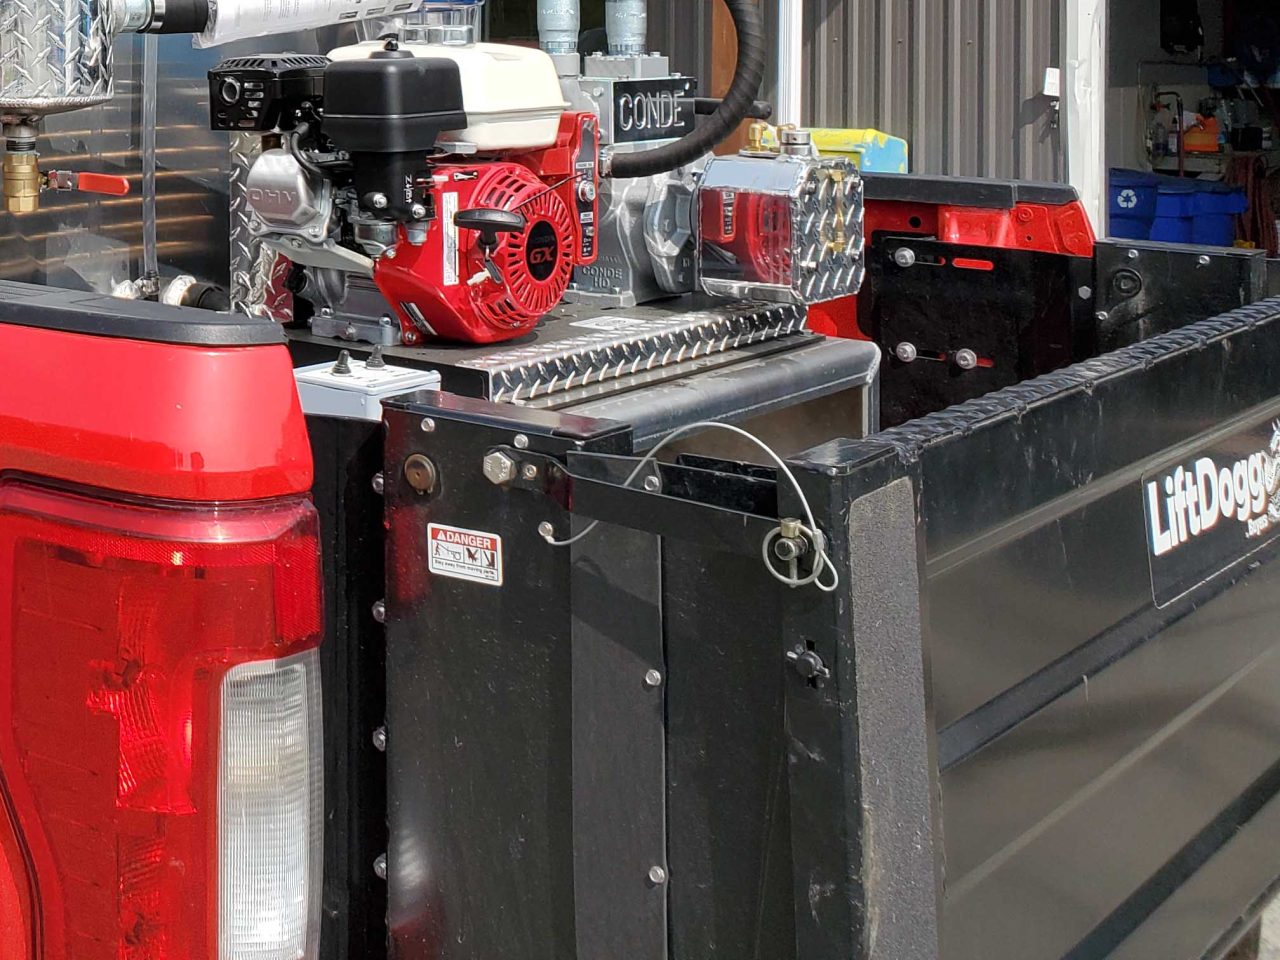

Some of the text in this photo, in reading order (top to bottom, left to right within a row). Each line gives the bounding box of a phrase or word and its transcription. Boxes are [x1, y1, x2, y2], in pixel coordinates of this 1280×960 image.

[619, 90, 685, 131] CONDE
[530, 245, 555, 264] GX
[593, 276, 610, 289] HD
[446, 531, 491, 550] DANGER
